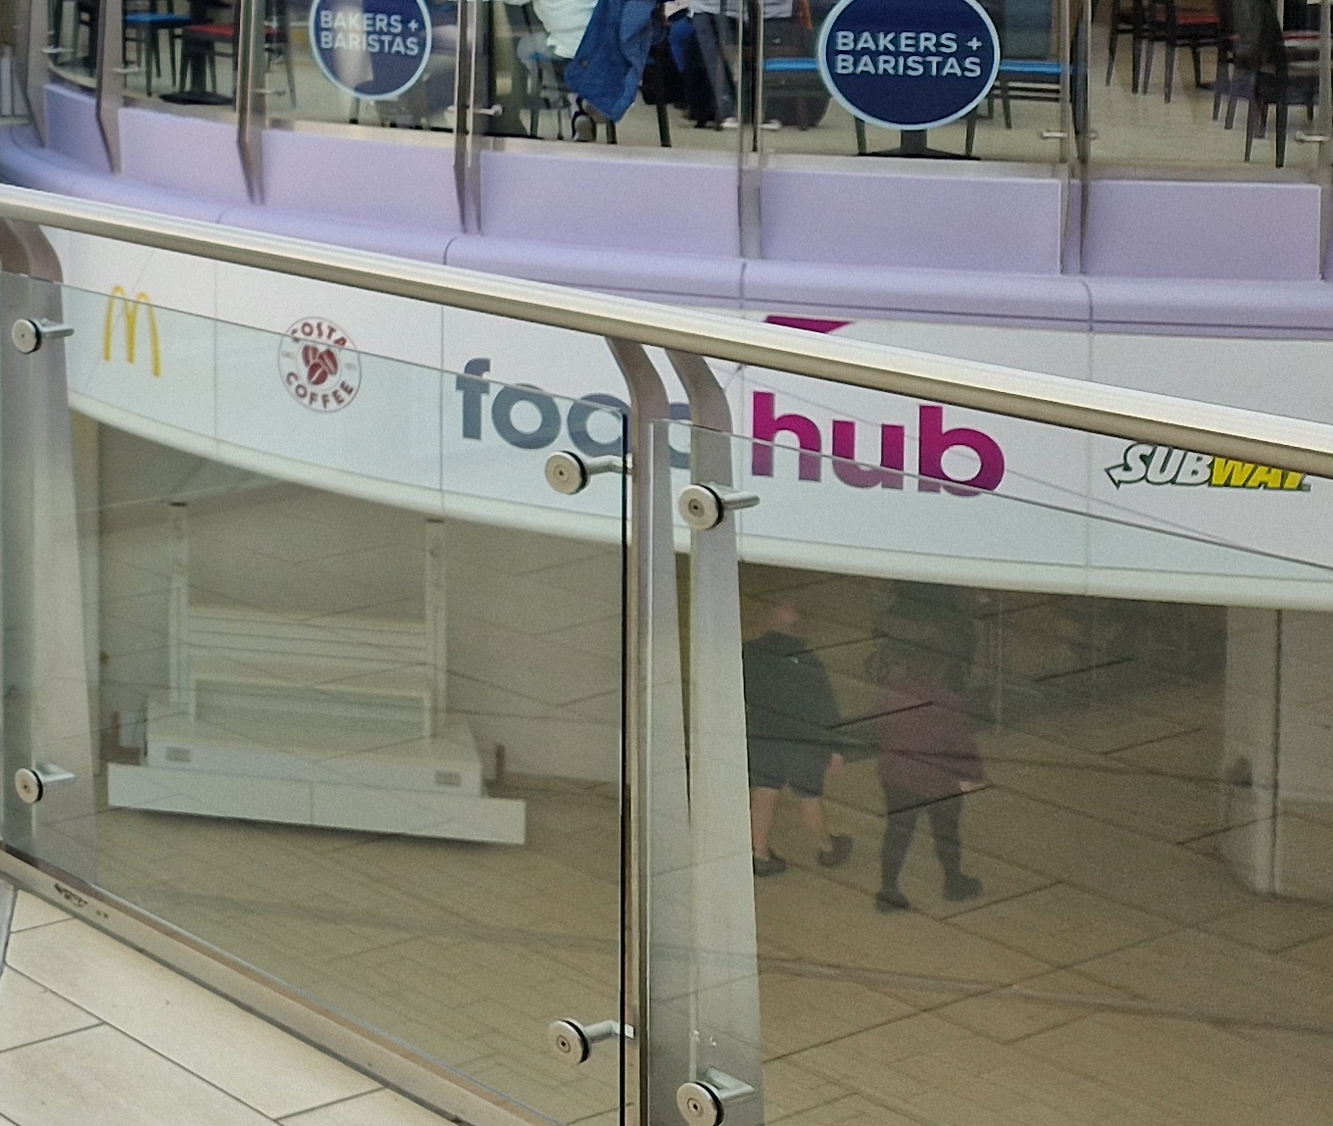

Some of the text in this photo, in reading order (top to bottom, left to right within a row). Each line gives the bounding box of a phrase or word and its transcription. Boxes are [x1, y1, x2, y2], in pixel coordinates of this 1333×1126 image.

[320, 10, 402, 34] BAKERS
[320, 31, 419, 56] BARISTAS
[836, 30, 982, 53] BAKERS +
[836, 54, 982, 77] BARISTAS
[290, 321, 348, 348] COSTA
[286, 371, 354, 409] COFFEE
[752, 390, 1006, 497] hub
